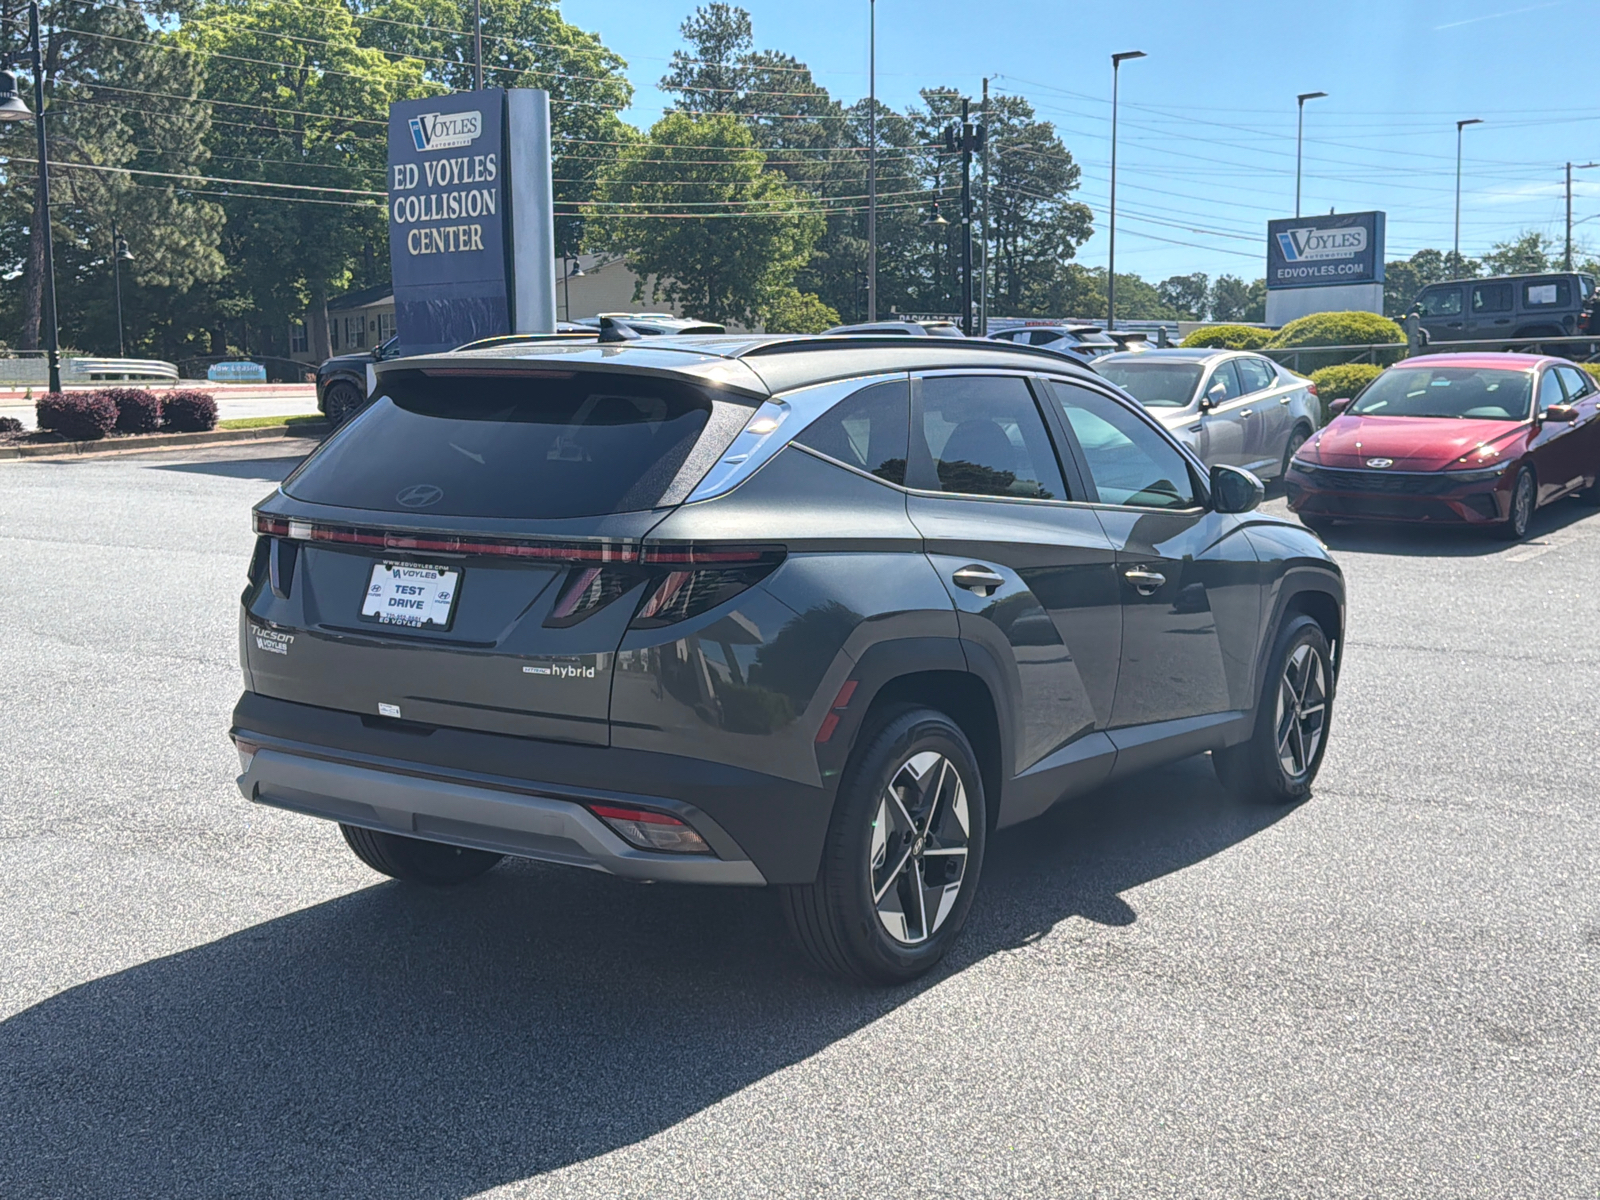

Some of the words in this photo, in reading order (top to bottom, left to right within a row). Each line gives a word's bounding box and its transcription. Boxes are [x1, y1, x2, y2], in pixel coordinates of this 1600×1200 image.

[419, 114, 477, 146] VOYLES
[431, 139, 470, 148] AUTOMOTIVE
[393, 163, 419, 191] ED
[424, 153, 497, 188] VOYLES
[393, 188, 497, 224] COLLISION
[407, 224, 484, 256] CENTER
[1289, 229, 1361, 257] VOYLES
[1277, 263, 1363, 279] EDVOYLES.COM
[948, 316, 979, 327] TOE
[231, 364, 264, 373] Leasing
[382, 559, 449, 571] WWW.EDVOYLES.COM
[402, 569, 437, 580] VOYLES
[395, 585, 425, 596] TEST
[388, 597, 425, 610] DRIVE
[391, 618, 422, 628] VOYLES
[263, 638, 287, 650] VOYLES
[552, 663, 595, 679] hybrid
